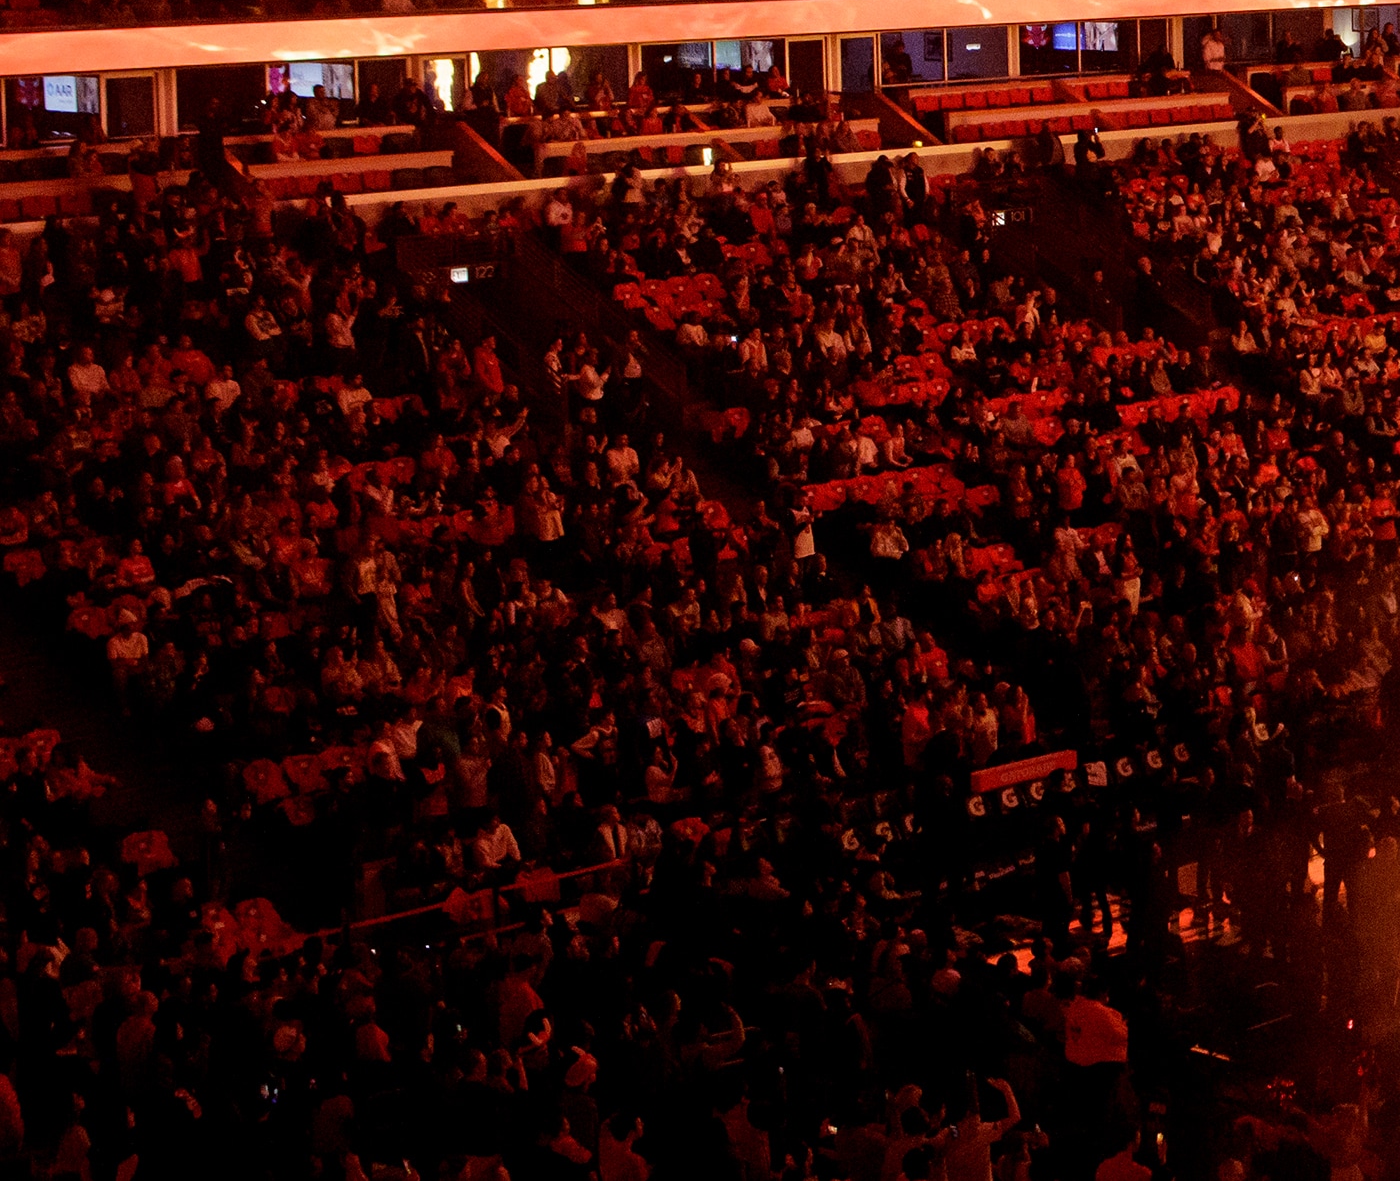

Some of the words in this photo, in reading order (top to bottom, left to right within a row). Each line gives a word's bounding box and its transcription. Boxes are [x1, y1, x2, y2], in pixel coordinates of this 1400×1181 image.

[1011, 211, 1026, 222] 101
[475, 265, 495, 279] 122
[1116, 756, 1133, 778] G
[1147, 749, 1164, 770] G
[969, 795, 986, 817] G
[1002, 788, 1019, 808] G
[842, 828, 860, 852] G
[875, 821, 894, 843] G
